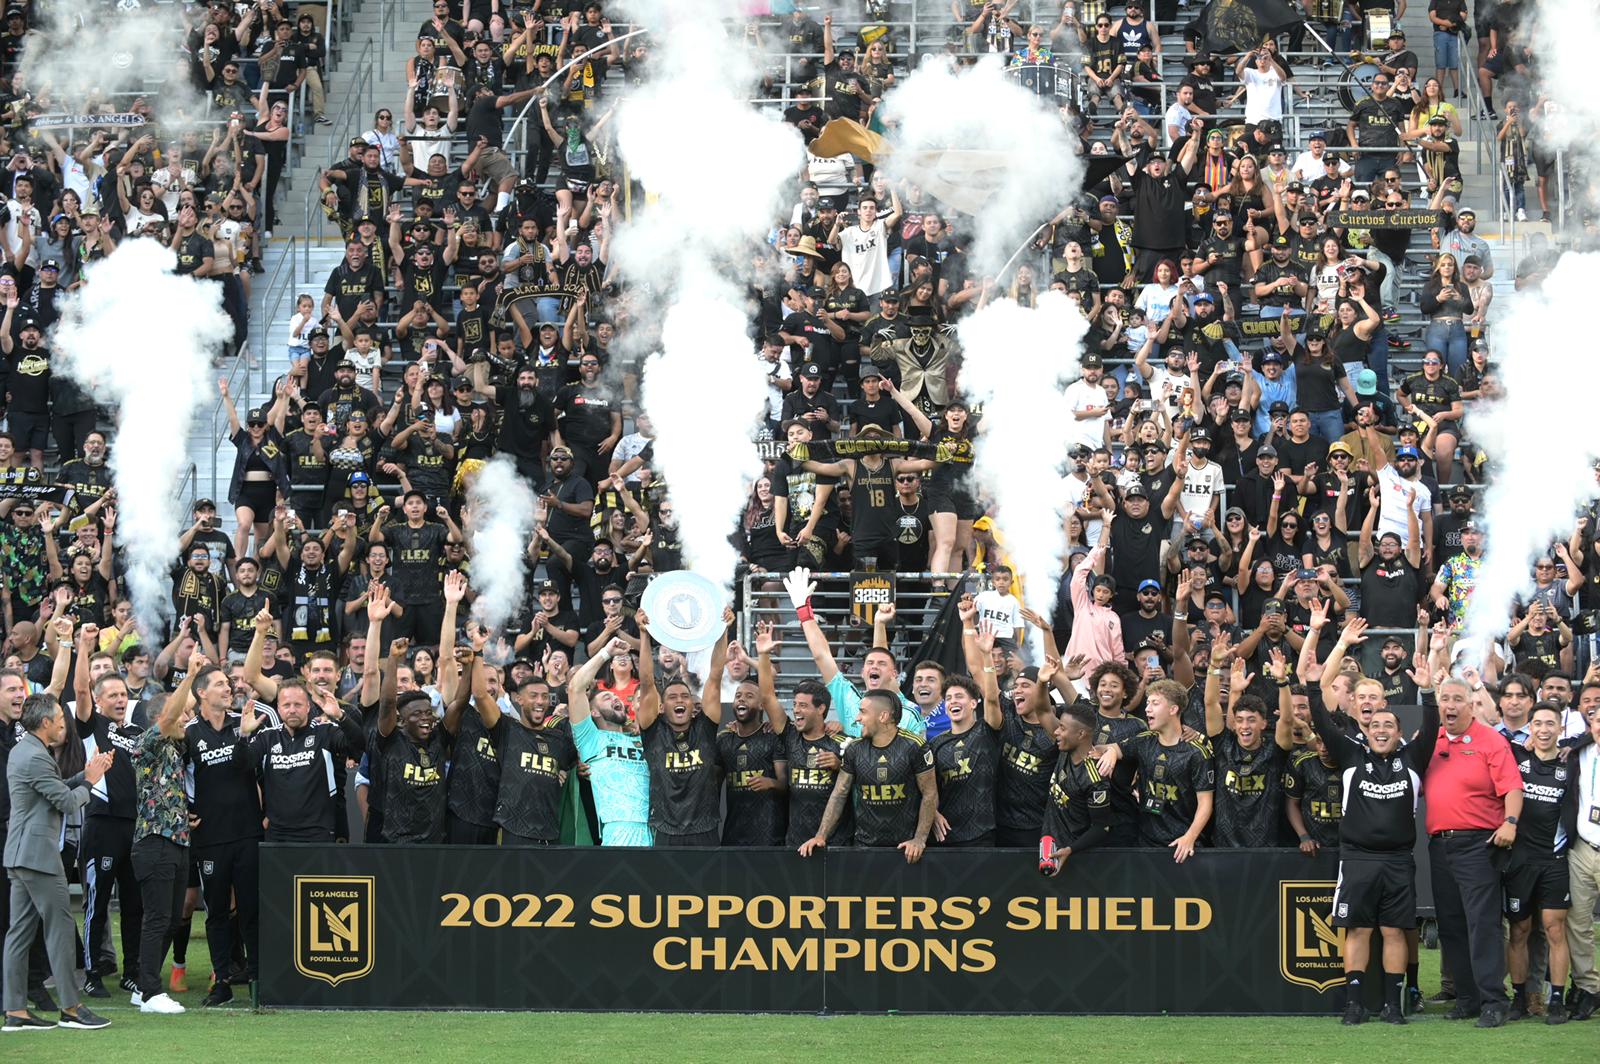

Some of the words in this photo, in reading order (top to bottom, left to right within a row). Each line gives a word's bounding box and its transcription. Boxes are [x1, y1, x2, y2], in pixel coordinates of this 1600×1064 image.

[74, 114, 91, 125] LOS
[93, 113, 145, 125] ANGELES
[1339, 211, 1386, 226] Cuervos
[1390, 211, 1437, 225] Cuervos
[341, 284, 366, 294] FLEX
[1243, 317, 1300, 334] CUERVS
[835, 440, 910, 455] CUERVOS
[298, 456, 326, 466] FLE
[1183, 484, 1211, 496] FLEX
[869, 489, 886, 507] 18
[401, 549, 430, 560] FLEX
[855, 588, 890, 603] 3252
[983, 609, 1010, 623] FLEX
[1262, 660, 1294, 677] FX
[107, 731, 136, 747] ROCKS
[201, 745, 235, 762] ROCKS
[270, 750, 315, 765] ROCKSTAR
[273, 761, 293, 770] ENERGY
[292, 760, 311, 768] DRINK
[404, 762, 440, 782] FLEX
[791, 768, 832, 785] FLEX
[862, 783, 905, 801] FLEX
[1359, 779, 1408, 794] ROCKSTAR
[1523, 780, 1564, 798] CKSTAR
[1363, 790, 1386, 800] ENERGY
[1386, 790, 1405, 799] DRINK
[1538, 794, 1557, 803] DRINK
[1311, 801, 1342, 818] FLE
[310, 890, 324, 898] LOS
[325, 890, 359, 898] ANGELES
[441, 893, 575, 927] 2022
[591, 894, 991, 929] SUPPORTERS’
[1006, 896, 1213, 930] SHIELD
[653, 936, 996, 972] CHAMPIONS
